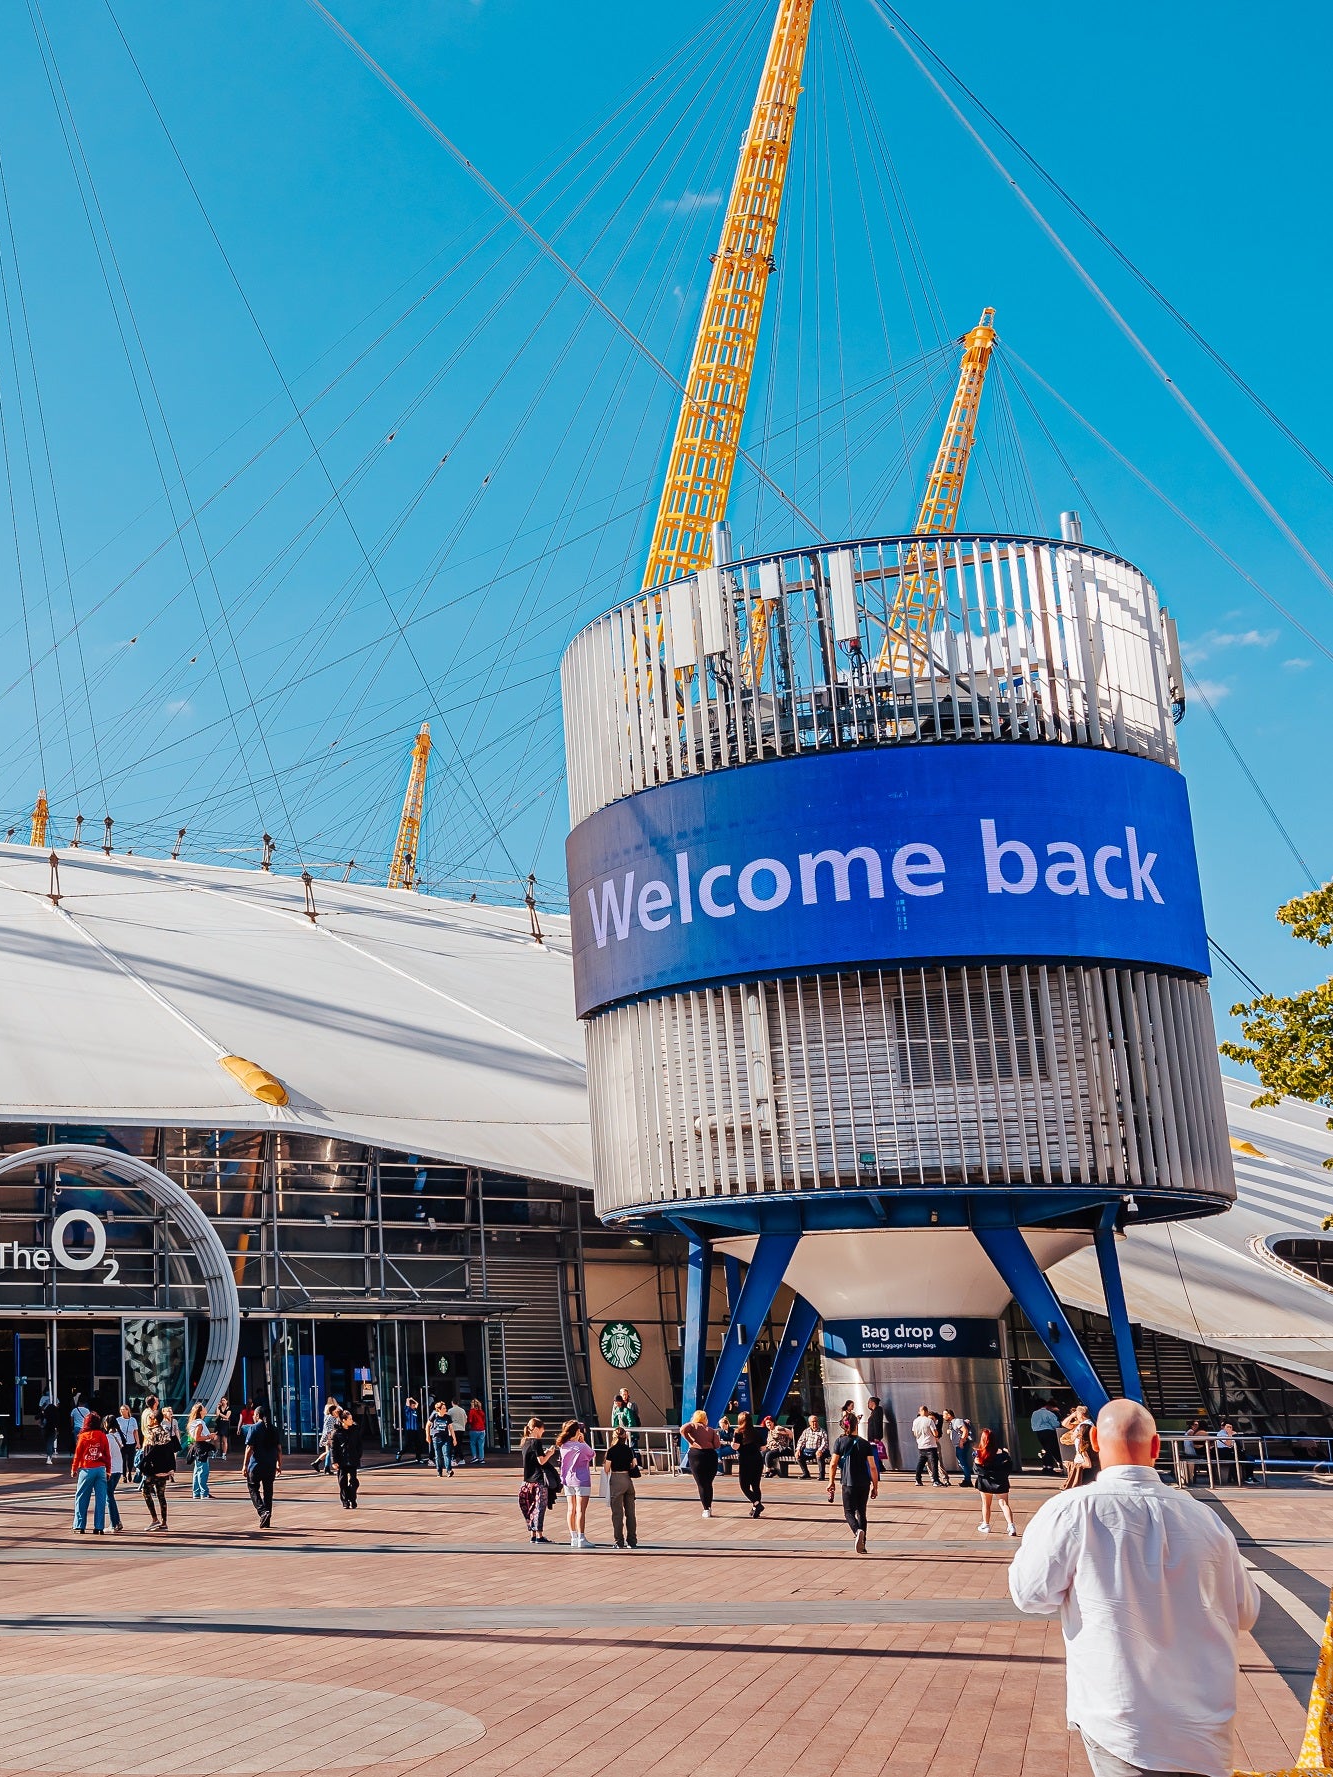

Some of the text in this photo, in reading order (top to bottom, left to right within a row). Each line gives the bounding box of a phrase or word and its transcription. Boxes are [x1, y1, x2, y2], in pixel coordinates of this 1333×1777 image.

[588, 818, 1165, 949] Welcome back
[51, 1209, 120, 1285] O2
[861, 1324, 934, 1341] Bag drop
